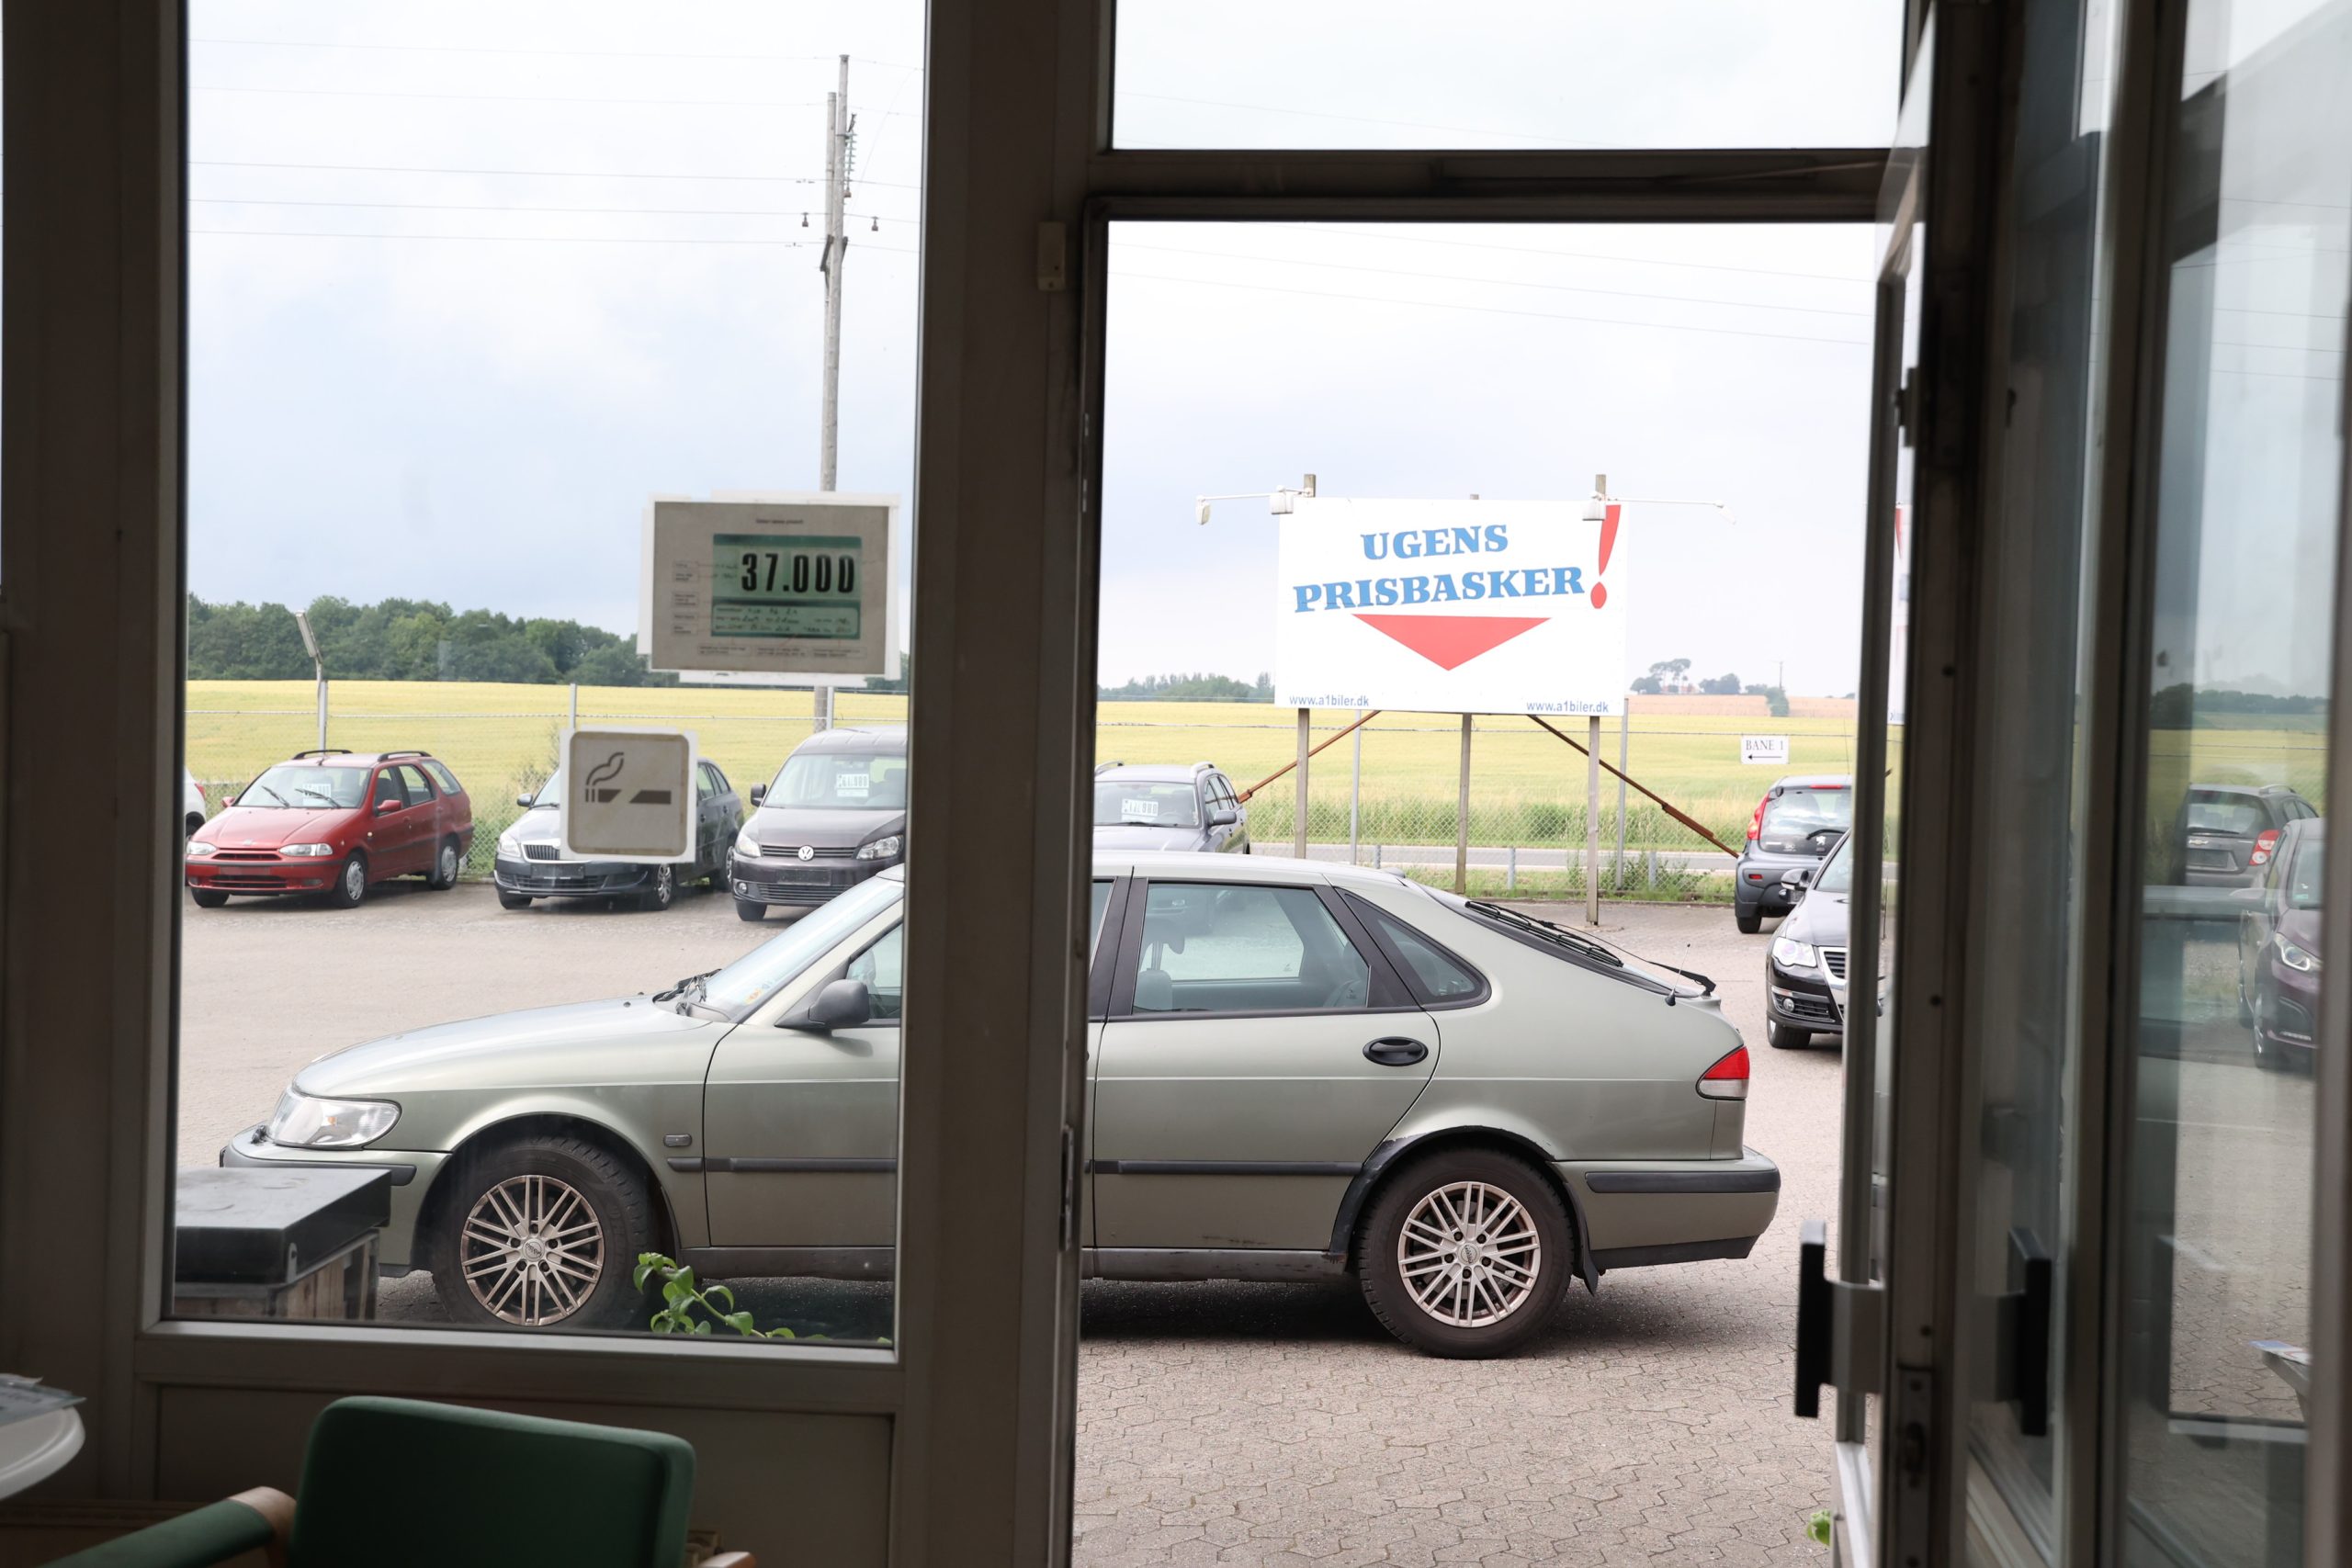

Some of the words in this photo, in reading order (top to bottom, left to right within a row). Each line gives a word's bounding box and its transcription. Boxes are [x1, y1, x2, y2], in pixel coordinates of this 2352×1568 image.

[1361, 525, 1509, 560] UGENS
[741, 553, 854, 593] 37.000
[1289, 694, 1369, 706] www.a1biler.dk
[1526, 700, 1609, 713] www.a1biler.dk
[1746, 739, 1774, 750] BANE
